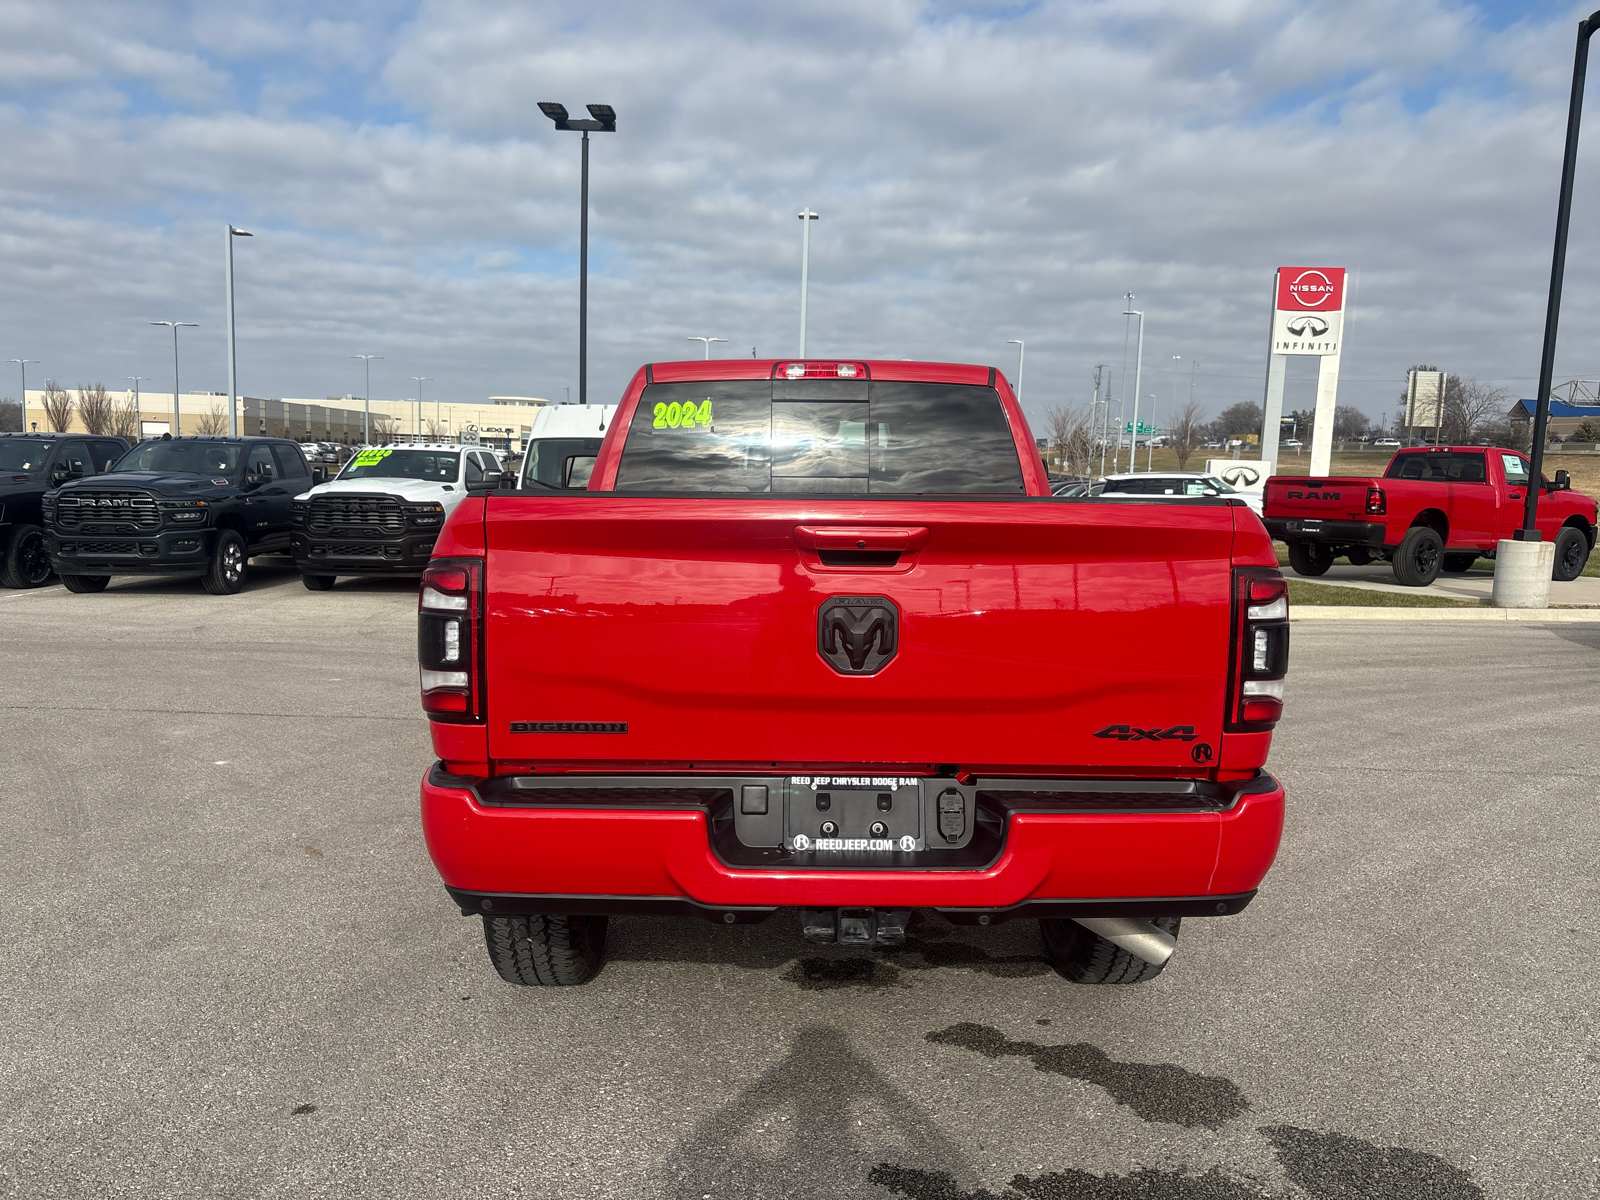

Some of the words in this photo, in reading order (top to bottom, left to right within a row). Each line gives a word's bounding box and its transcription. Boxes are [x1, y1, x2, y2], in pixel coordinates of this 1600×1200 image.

[1276, 341, 1337, 351] INFINITI
[653, 400, 713, 430] 2024
[1287, 491, 1341, 501] RAM
[79, 498, 130, 507] RAM
[331, 502, 379, 512] RAM
[510, 721, 628, 734] BIGHORN
[1092, 724, 1200, 742] 4x4
[791, 777, 810, 785] REED
[812, 777, 830, 785] JEEP
[832, 777, 870, 786] CHRYSLER
[872, 778, 897, 786] DODGE
[899, 778, 917, 786] RAM
[816, 839, 893, 850] REEDJEEP.COM
